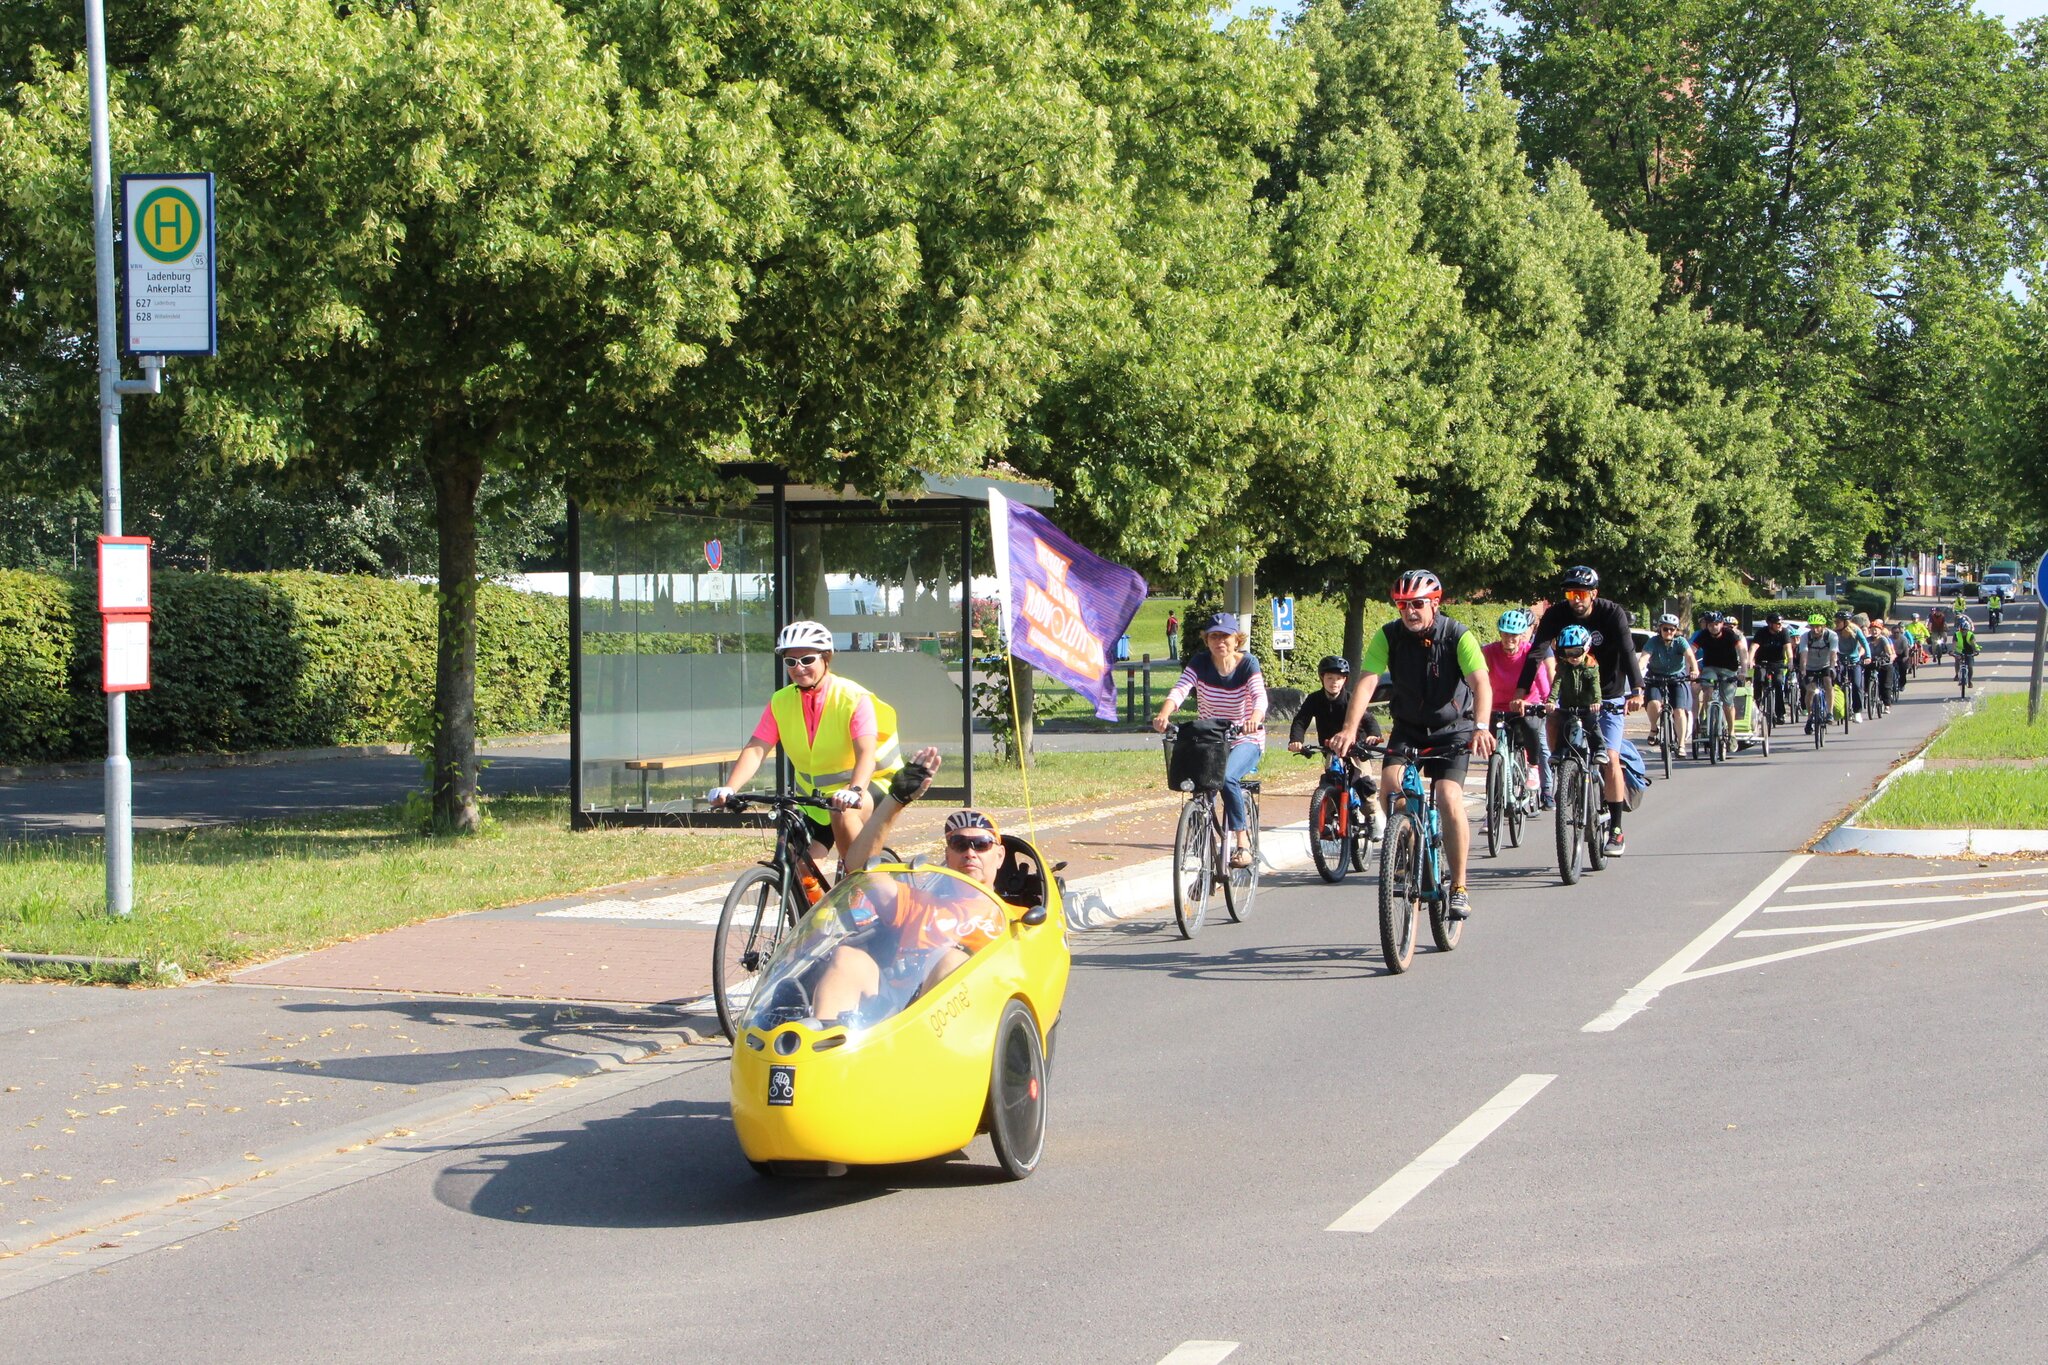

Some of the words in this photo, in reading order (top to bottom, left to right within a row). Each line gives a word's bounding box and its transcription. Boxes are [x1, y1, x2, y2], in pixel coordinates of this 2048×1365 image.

[155, 204, 181, 245] H
[195, 258, 204, 266] 95
[147, 272, 191, 282] Ladenburg
[146, 284, 192, 294] Ankerplatz
[136, 299, 151, 307] 627
[136, 312, 152, 321] 628
[947, 811, 987, 831] ADFC
